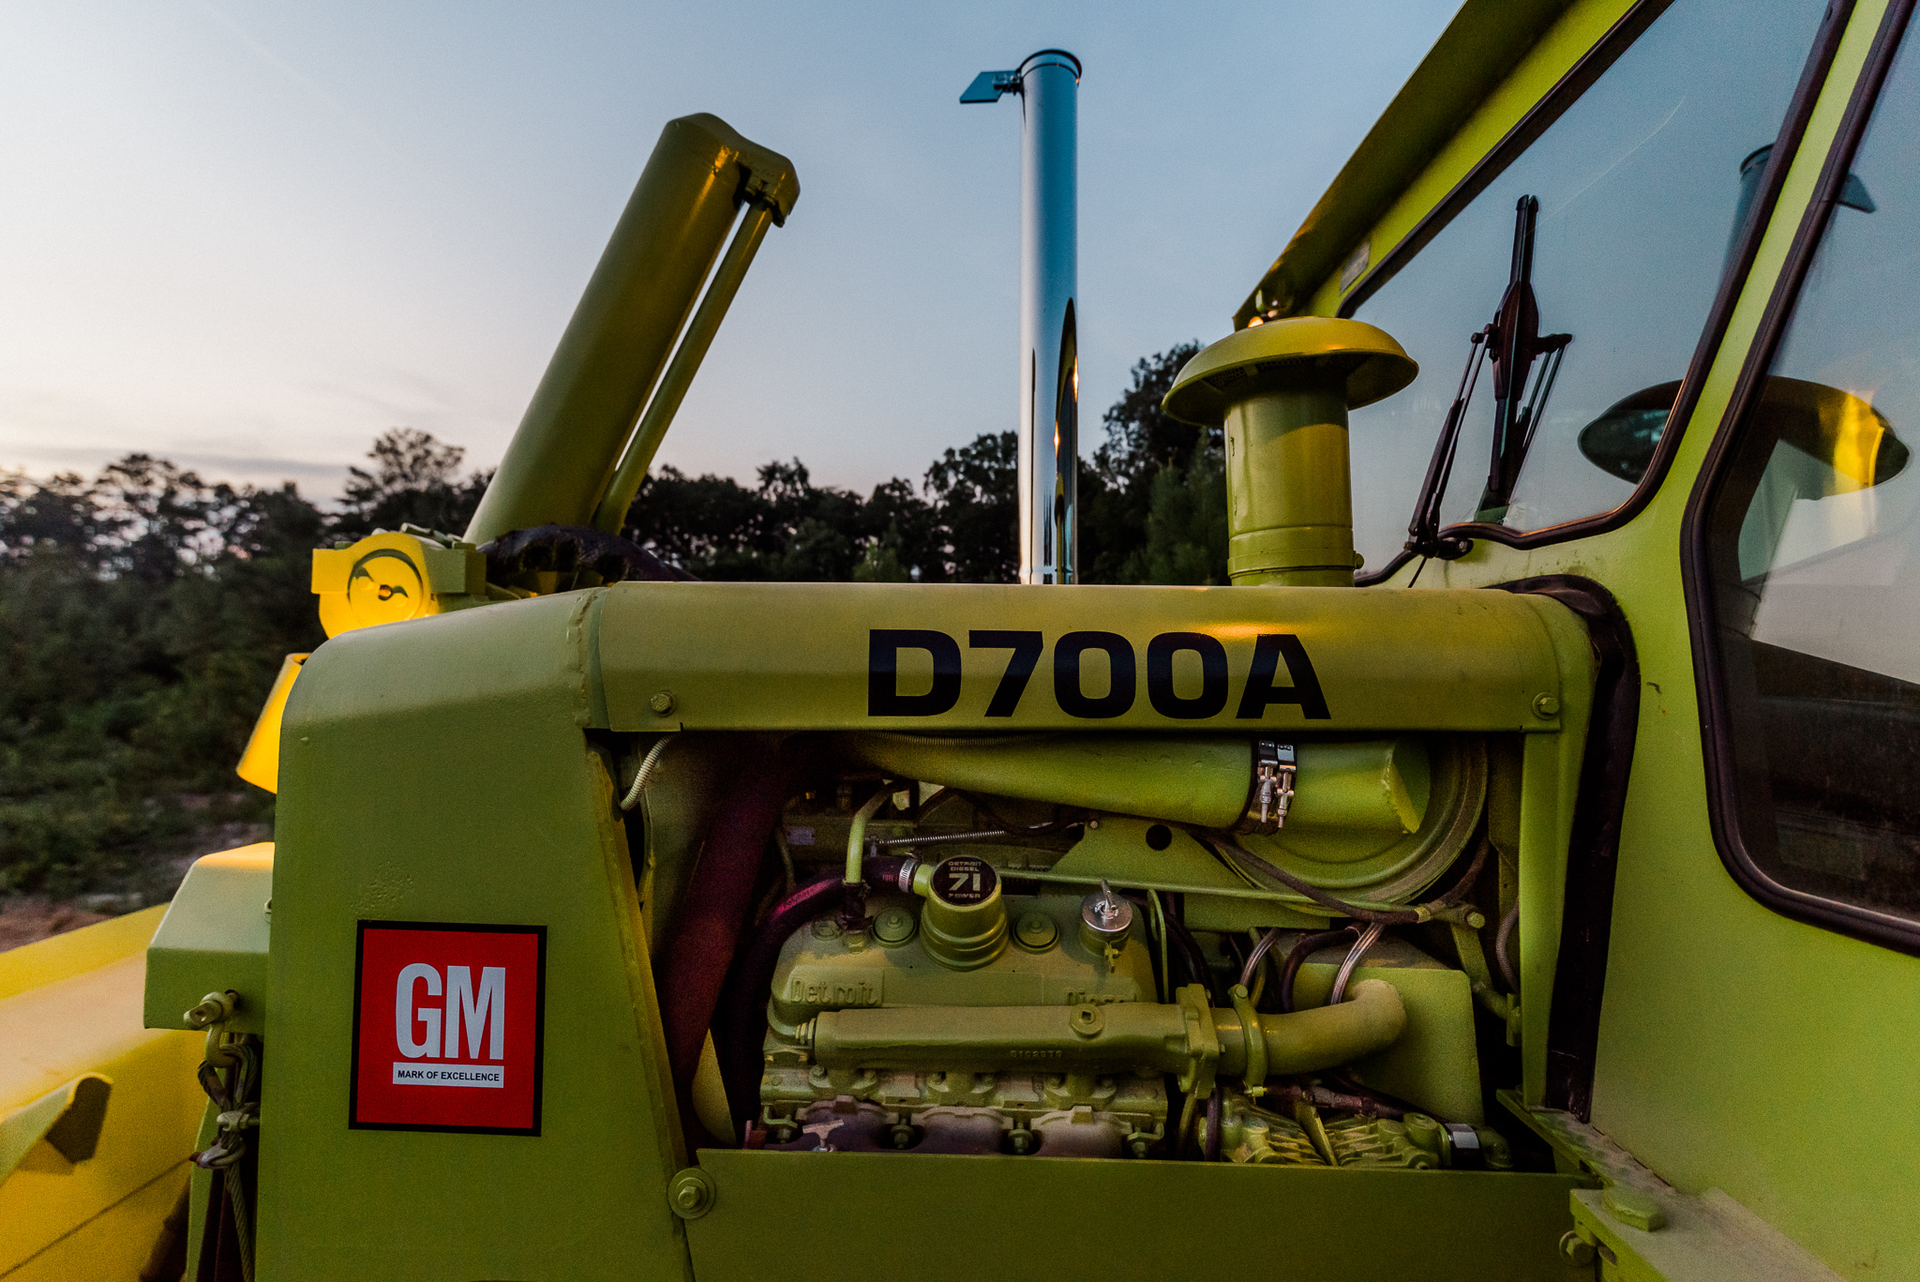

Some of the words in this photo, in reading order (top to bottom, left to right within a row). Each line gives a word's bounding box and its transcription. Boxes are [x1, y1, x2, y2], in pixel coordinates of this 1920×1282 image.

[868, 629, 1331, 720] D700A
[949, 873, 980, 891] 71
[790, 979, 878, 1006] Detroit
[395, 962, 506, 1060] GM
[397, 1070, 424, 1079] MARK
[426, 1071, 439, 1079] OF
[441, 1071, 500, 1082] EXCELLENCE
